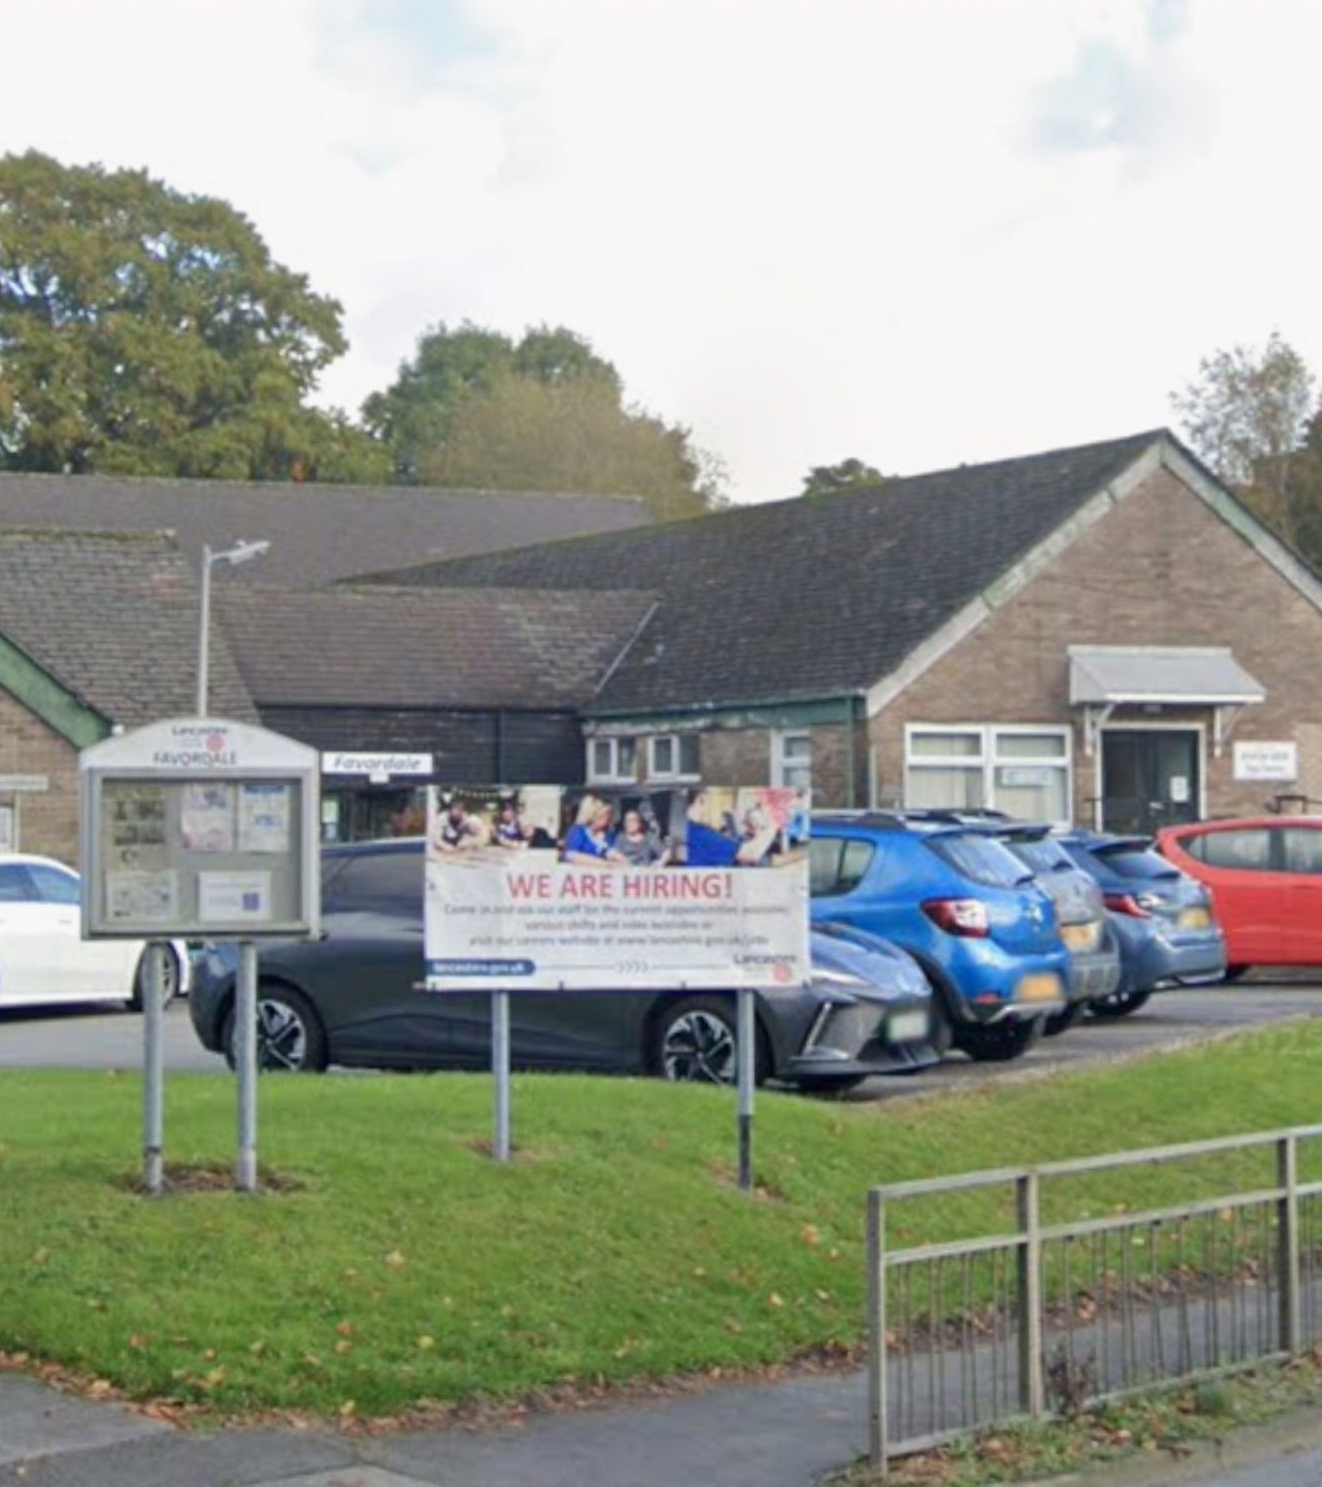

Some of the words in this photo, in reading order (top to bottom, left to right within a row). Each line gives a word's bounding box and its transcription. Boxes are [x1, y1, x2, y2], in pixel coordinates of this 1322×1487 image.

[334, 754, 422, 770] Favordale
[507, 873, 552, 898] WE
[559, 873, 614, 899] ARE
[622, 873, 733, 899] HIRING!
